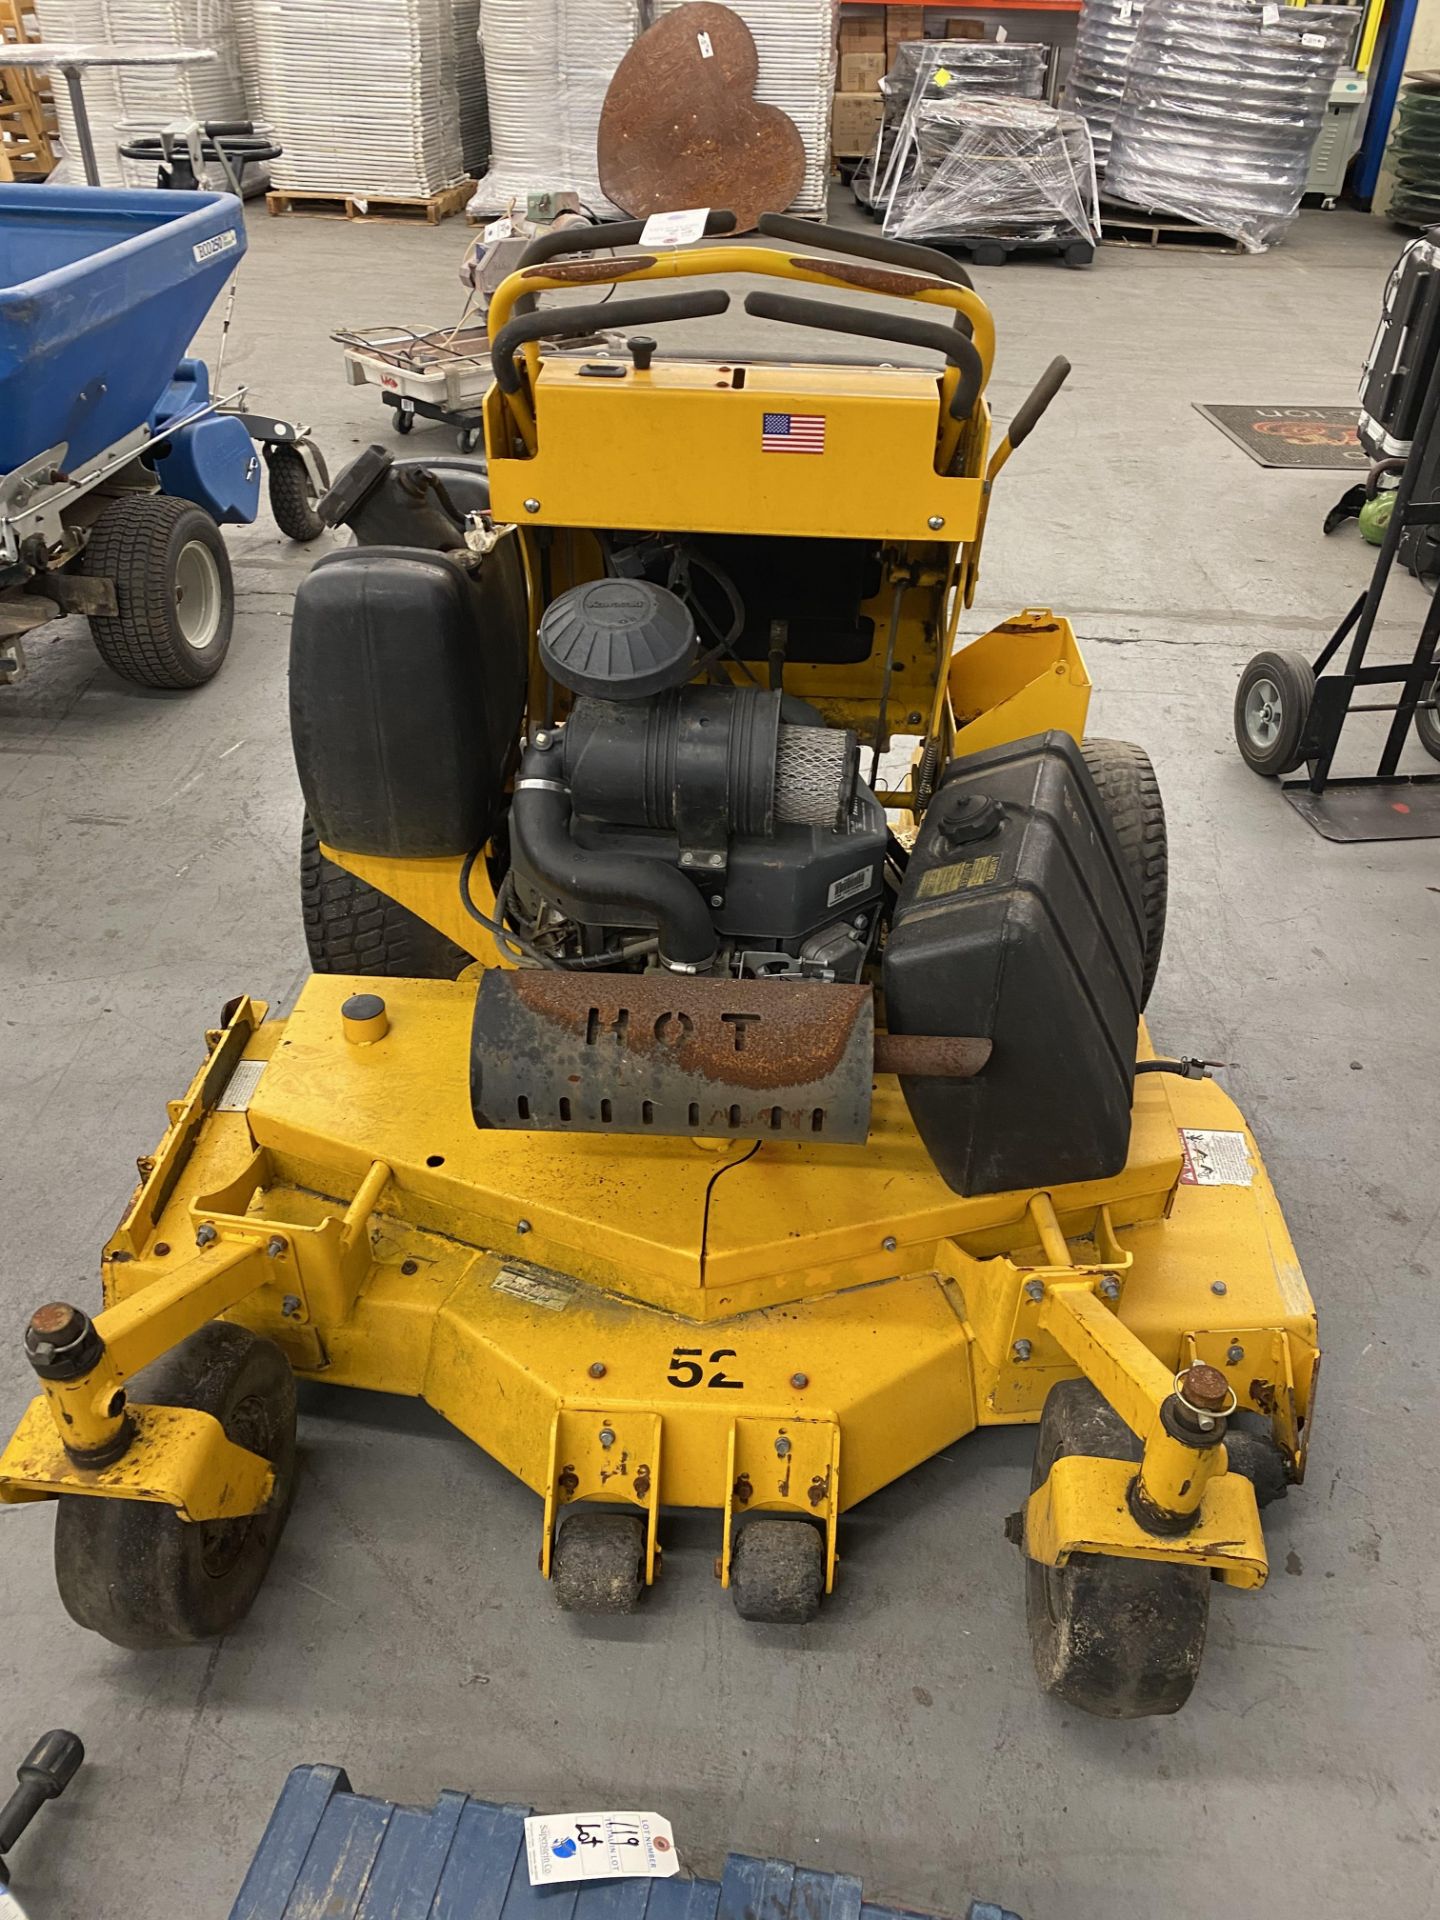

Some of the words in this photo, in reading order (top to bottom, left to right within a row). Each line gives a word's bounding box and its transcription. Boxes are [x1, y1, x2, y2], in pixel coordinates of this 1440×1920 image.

[586, 1007, 761, 1051] HOT
[667, 1347, 744, 1389] 52
[575, 1824, 604, 1848] Lot
[608, 1822, 640, 1847] 119
